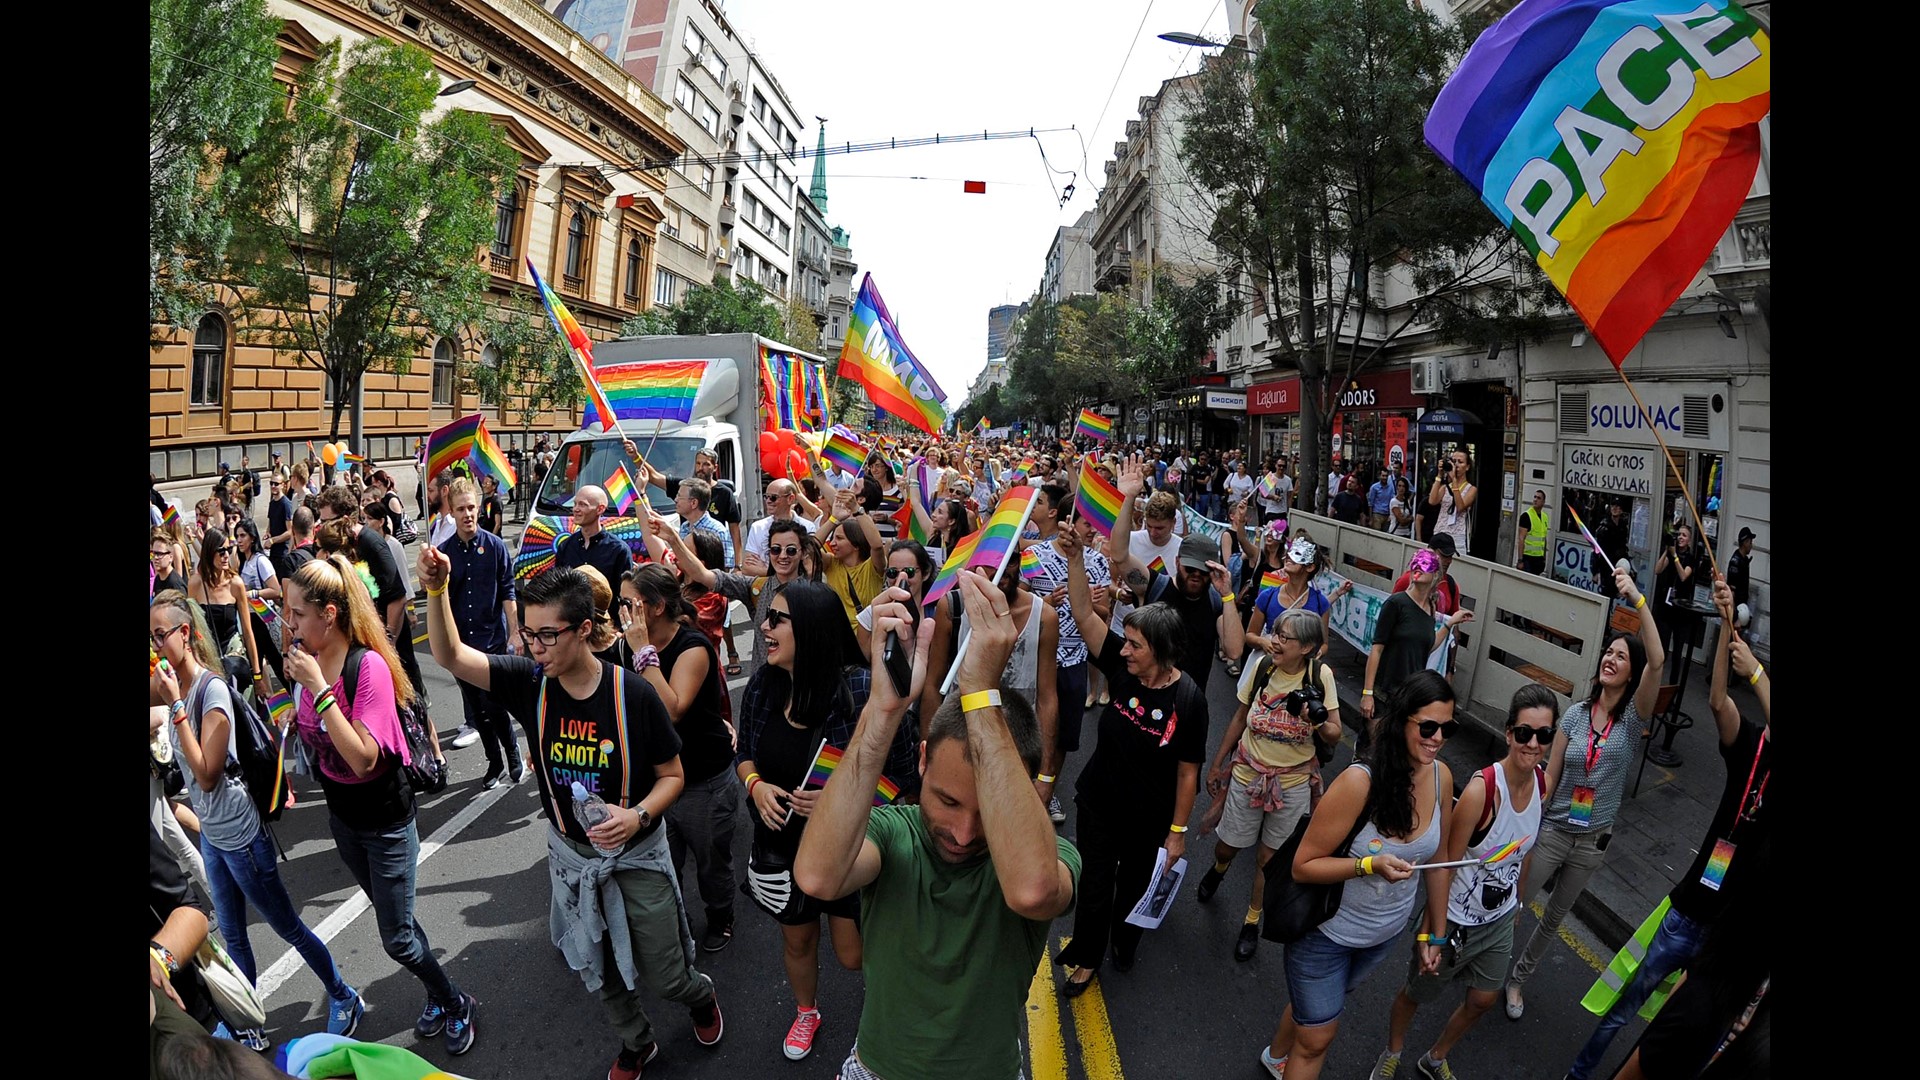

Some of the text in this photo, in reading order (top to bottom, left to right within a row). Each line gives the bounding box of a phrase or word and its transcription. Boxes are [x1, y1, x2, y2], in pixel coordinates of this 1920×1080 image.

[1504, 3, 1763, 259] PACE
[1256, 389, 1287, 409] Laguna
[1340, 389, 1375, 407] UDORS
[1591, 404, 1681, 431] SOLUNAC
[1571, 449, 1645, 471] GRČKI GYROS
[1565, 469, 1650, 494] GRČKI SUVLAKI
[560, 717, 598, 743] LOVE
[550, 741, 563, 763] IS
[565, 743, 597, 767] NOT
[597, 750, 610, 769] A
